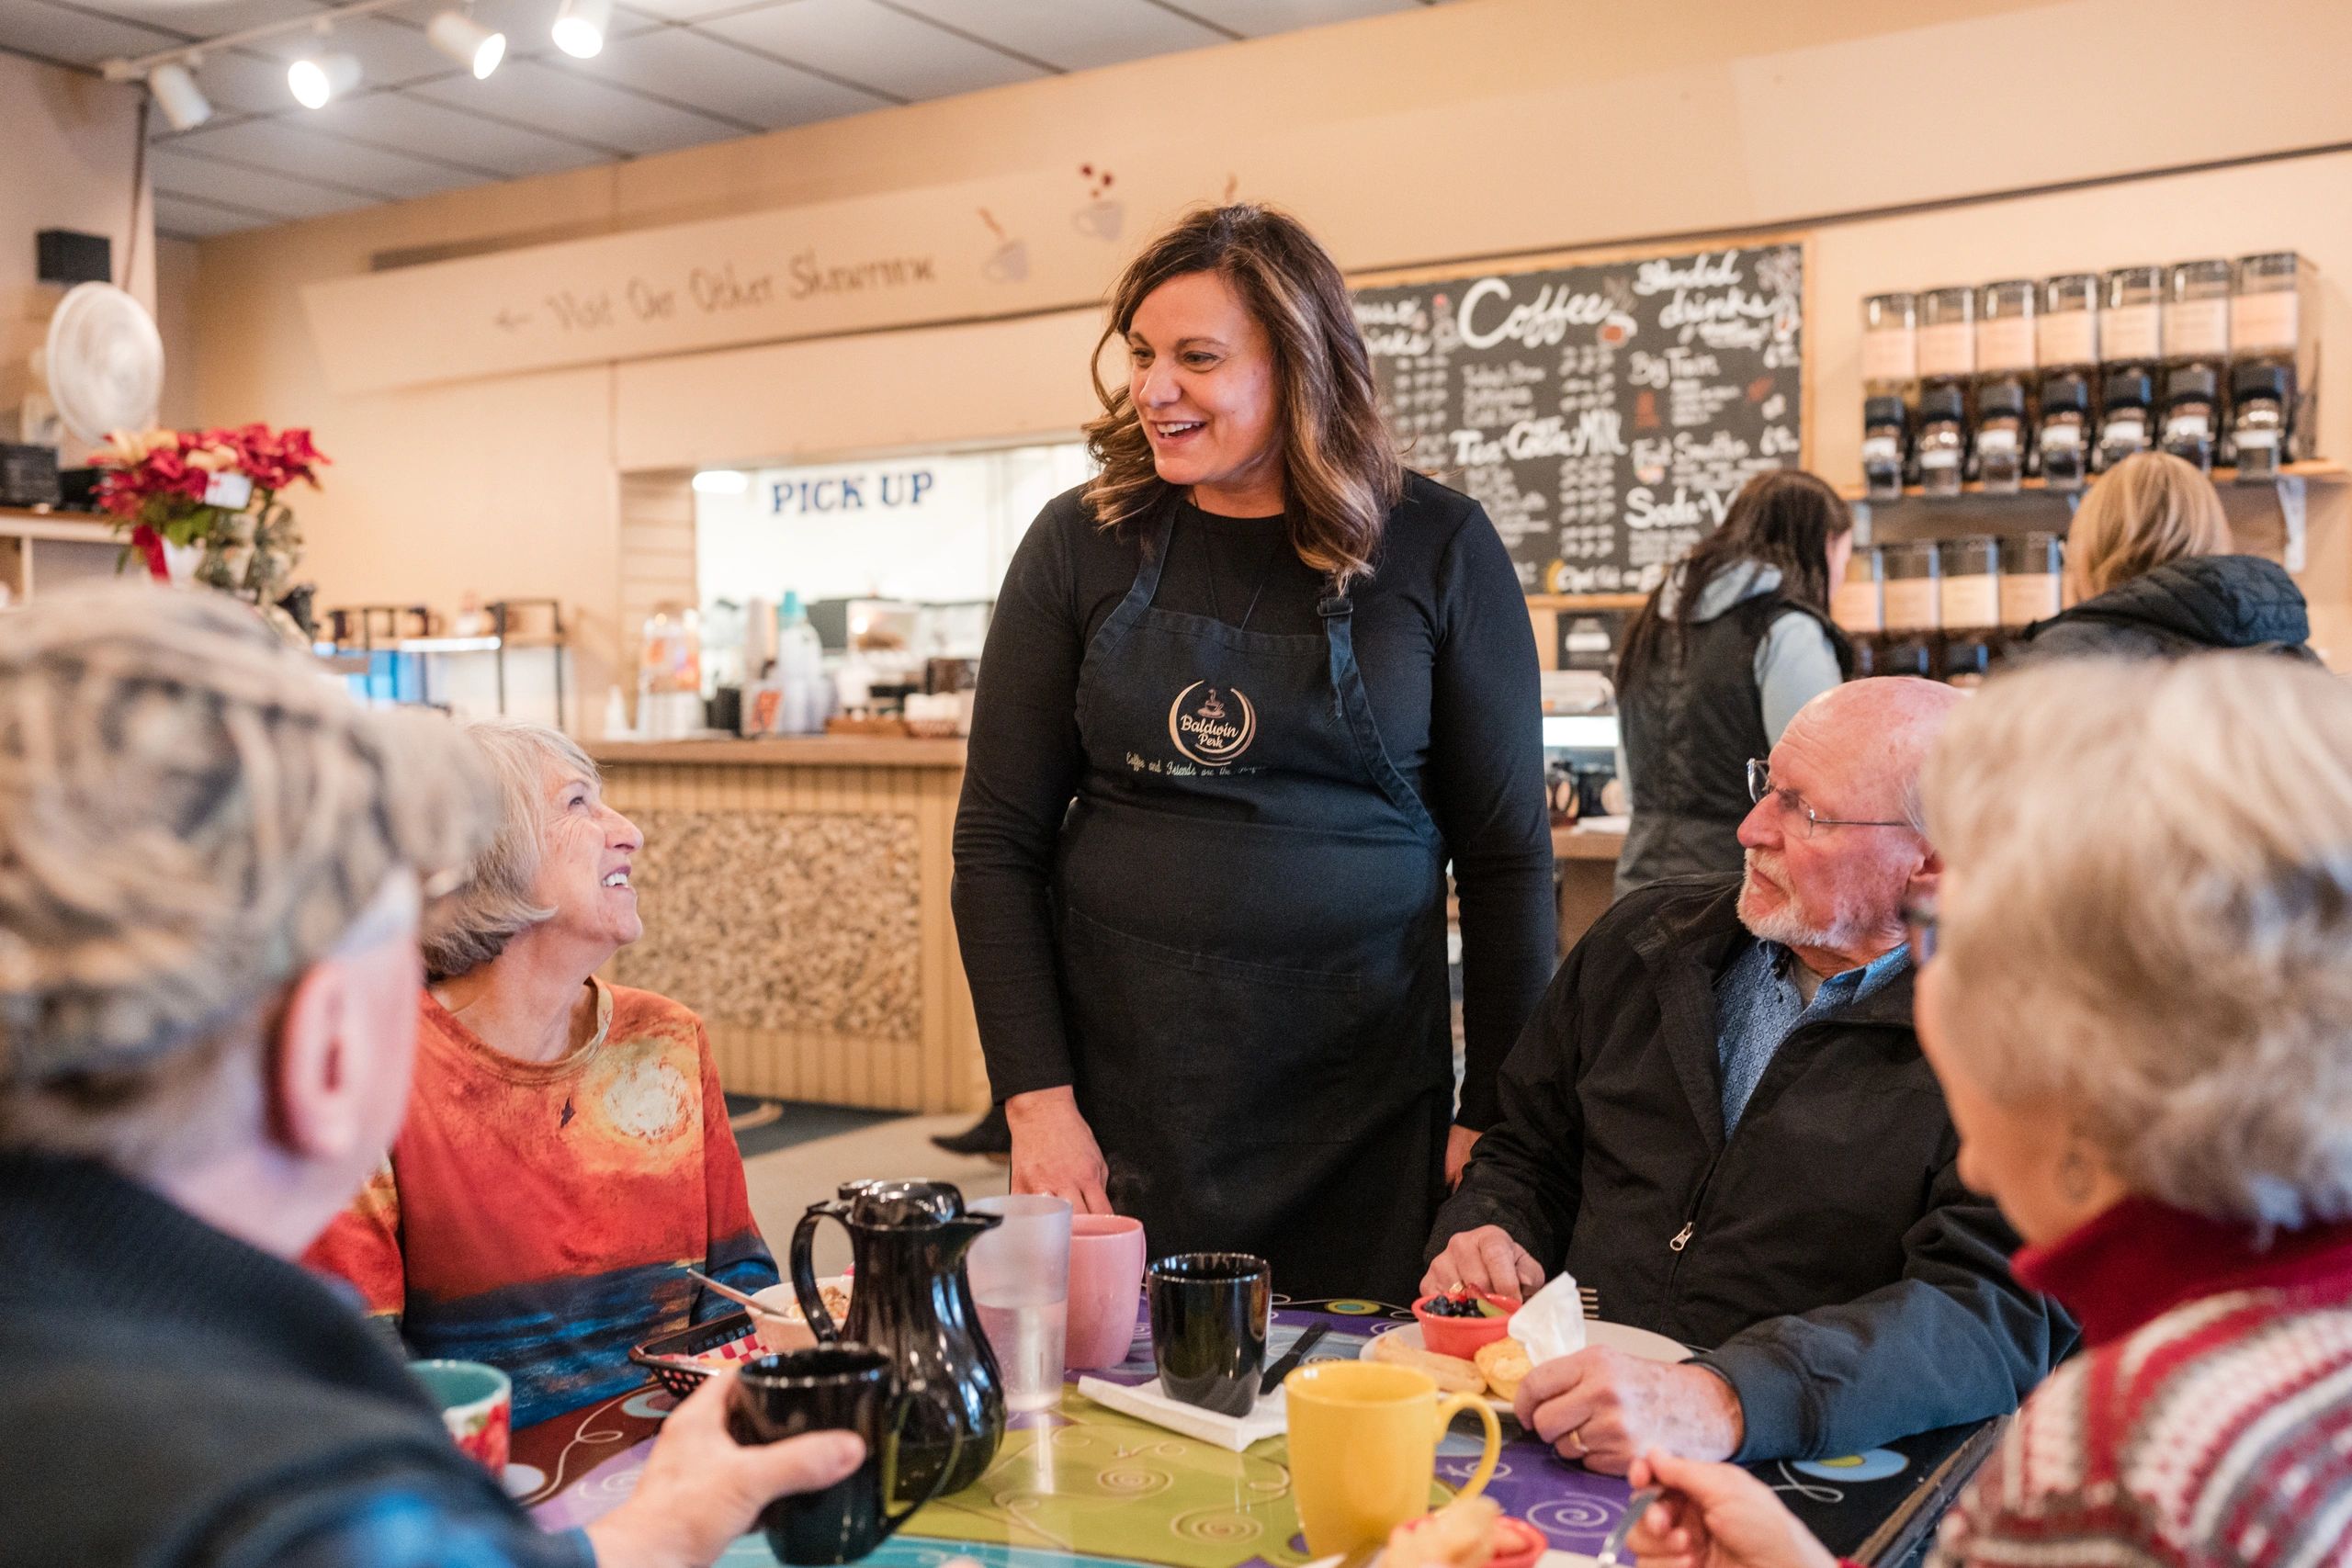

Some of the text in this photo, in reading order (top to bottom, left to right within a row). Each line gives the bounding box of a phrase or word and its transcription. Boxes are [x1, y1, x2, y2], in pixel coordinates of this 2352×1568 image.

[1457, 278, 1614, 349] Coffee
[773, 470, 933, 513] PICK UP
[1180, 713, 1239, 738] Baldwin
[1197, 733, 1224, 749] Perk
[1148, 760, 1161, 773] and
[1166, 761, 1197, 776] Friends
